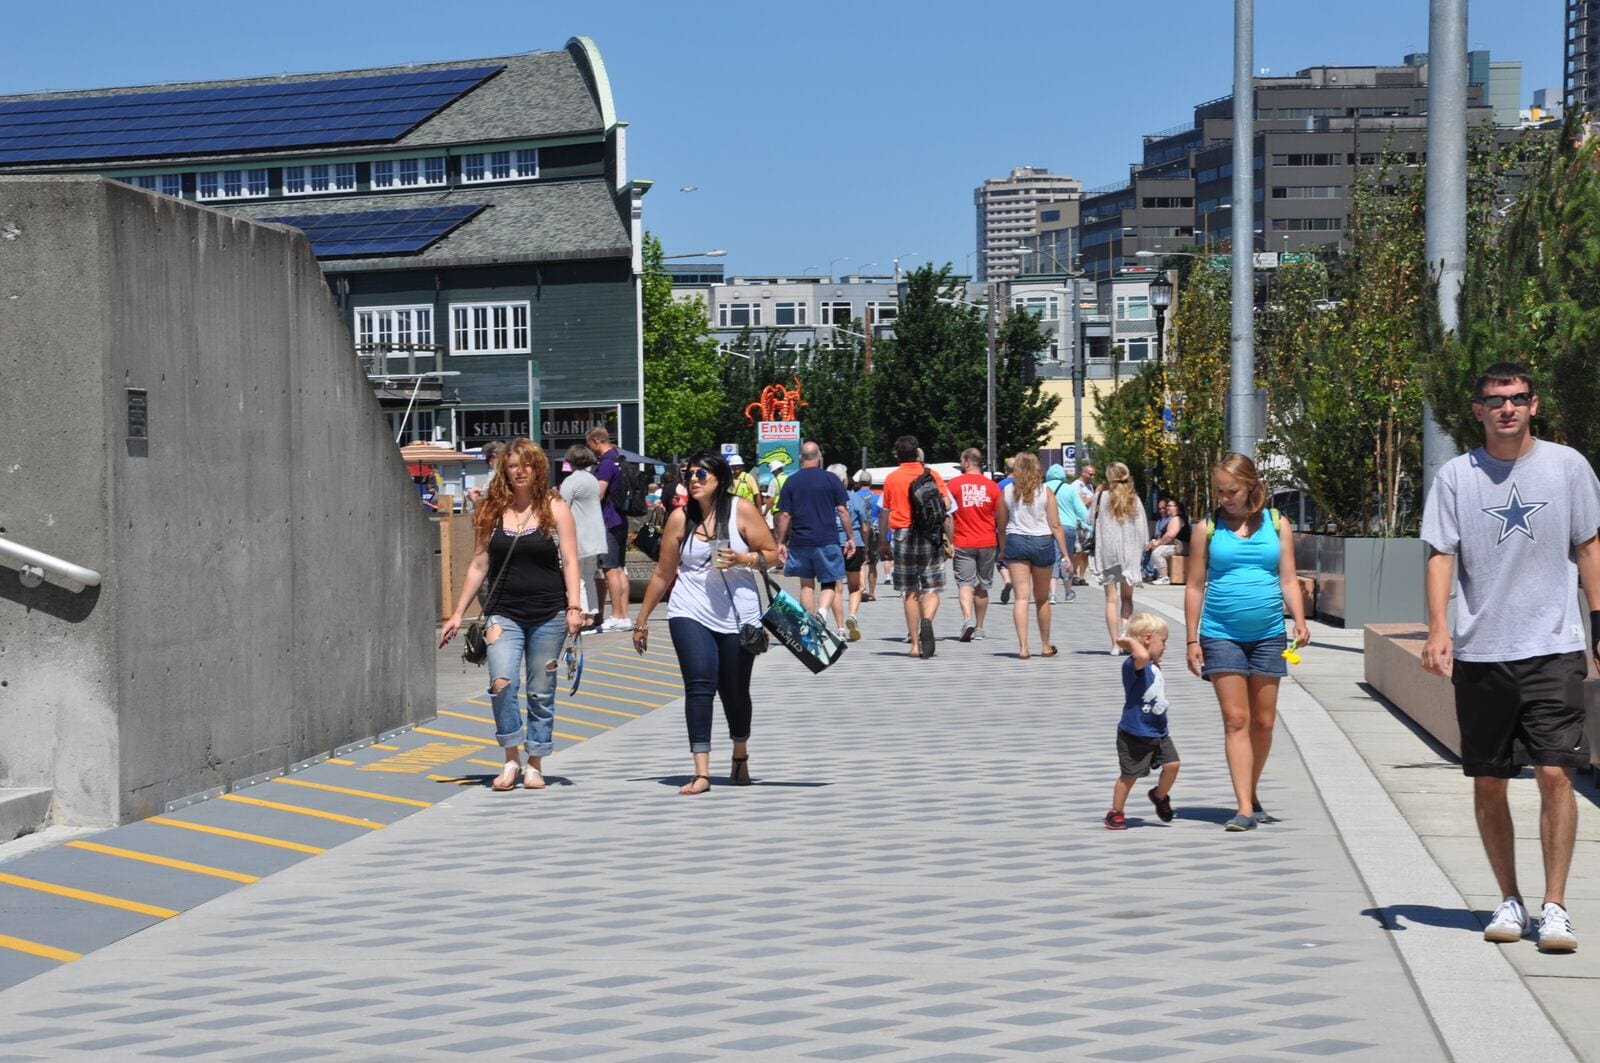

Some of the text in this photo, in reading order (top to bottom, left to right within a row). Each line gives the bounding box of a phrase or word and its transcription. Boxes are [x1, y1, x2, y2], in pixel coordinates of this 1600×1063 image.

[473, 420, 608, 436] SEATTLE QUARIU
[761, 423, 797, 433] Enter
